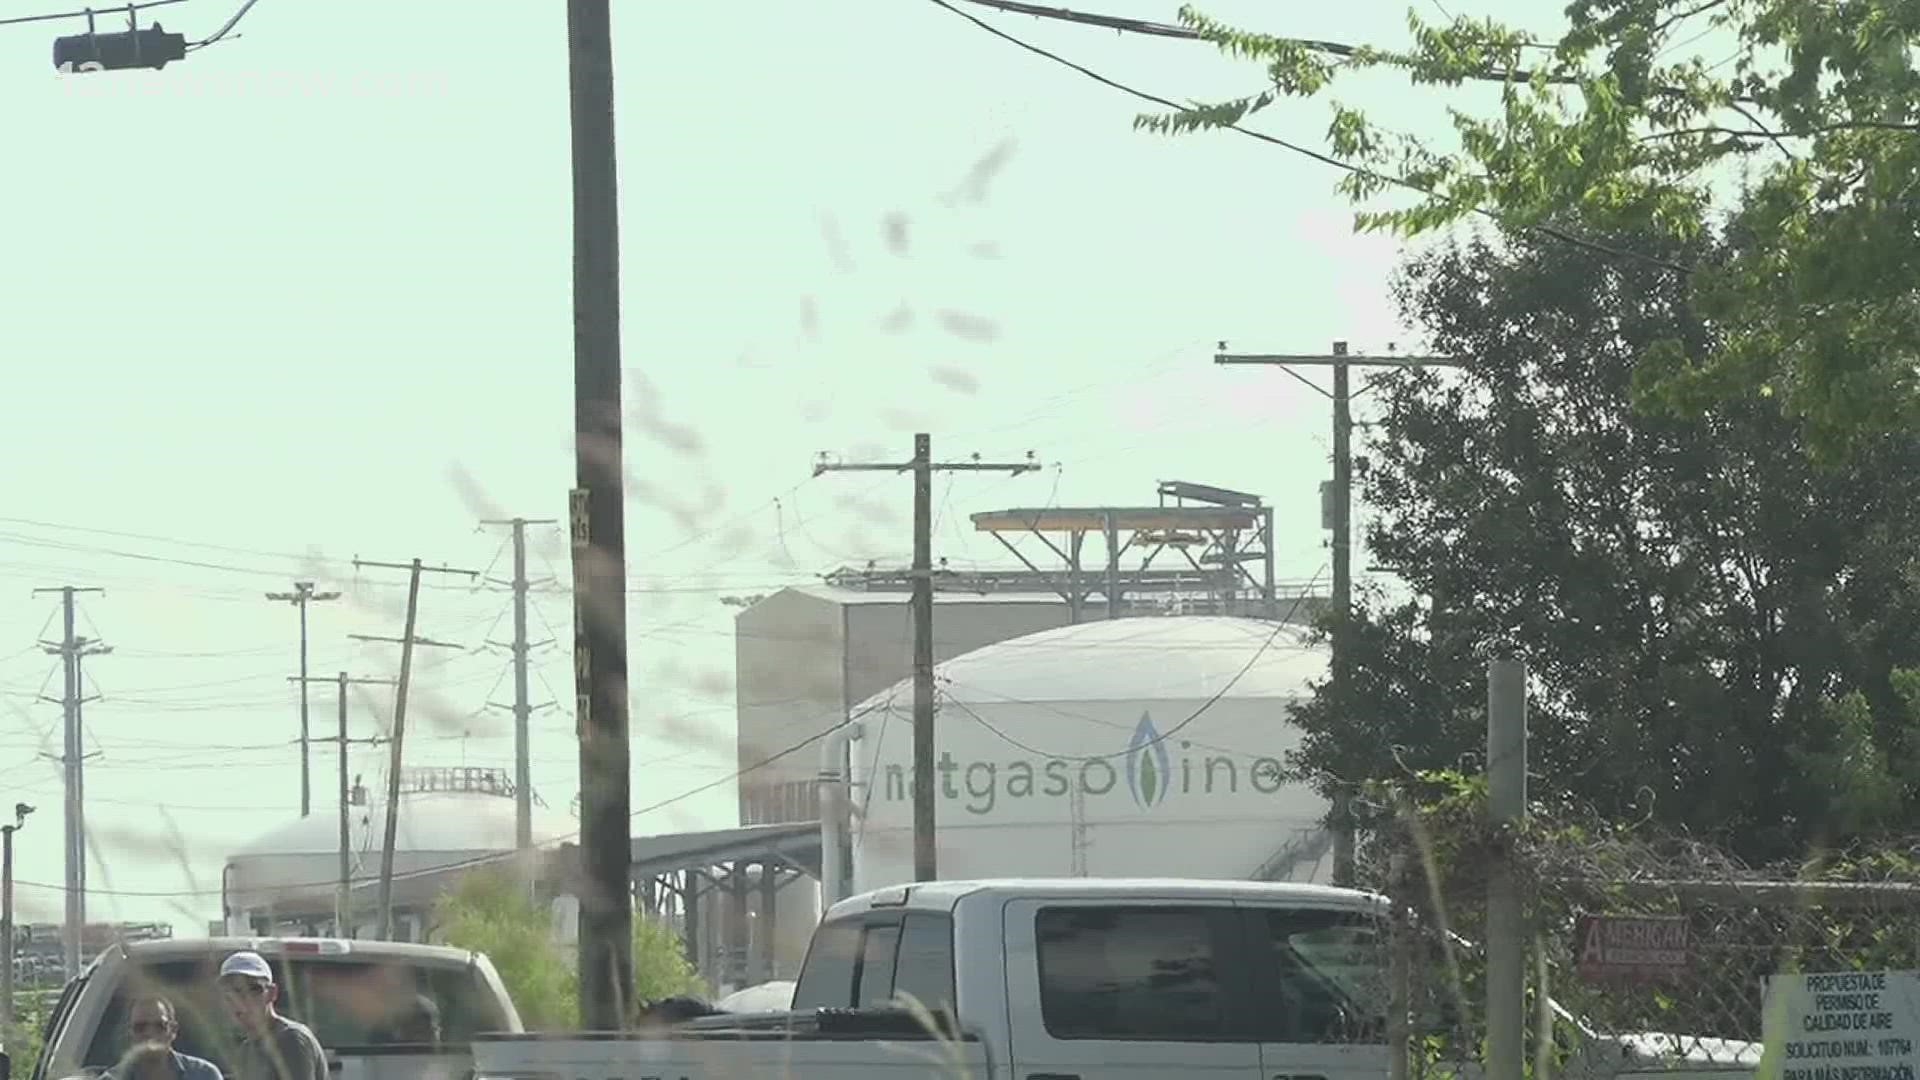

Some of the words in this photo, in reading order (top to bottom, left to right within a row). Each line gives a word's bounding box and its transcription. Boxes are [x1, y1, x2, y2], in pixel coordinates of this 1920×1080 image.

[1583, 918, 1688, 961] AMERICAN
[1807, 975, 1871, 991] PROPUESTA
[1872, 974, 1886, 990] DE
[1816, 994, 1863, 1011] PERMISO
[1865, 994, 1880, 1010] DE
[1803, 1014, 1851, 1031] CALIDAD
[1853, 1013, 1868, 1030] DE
[1869, 1013, 1893, 1029] AIRE
[1785, 1040, 1841, 1058] SOLICITUD
